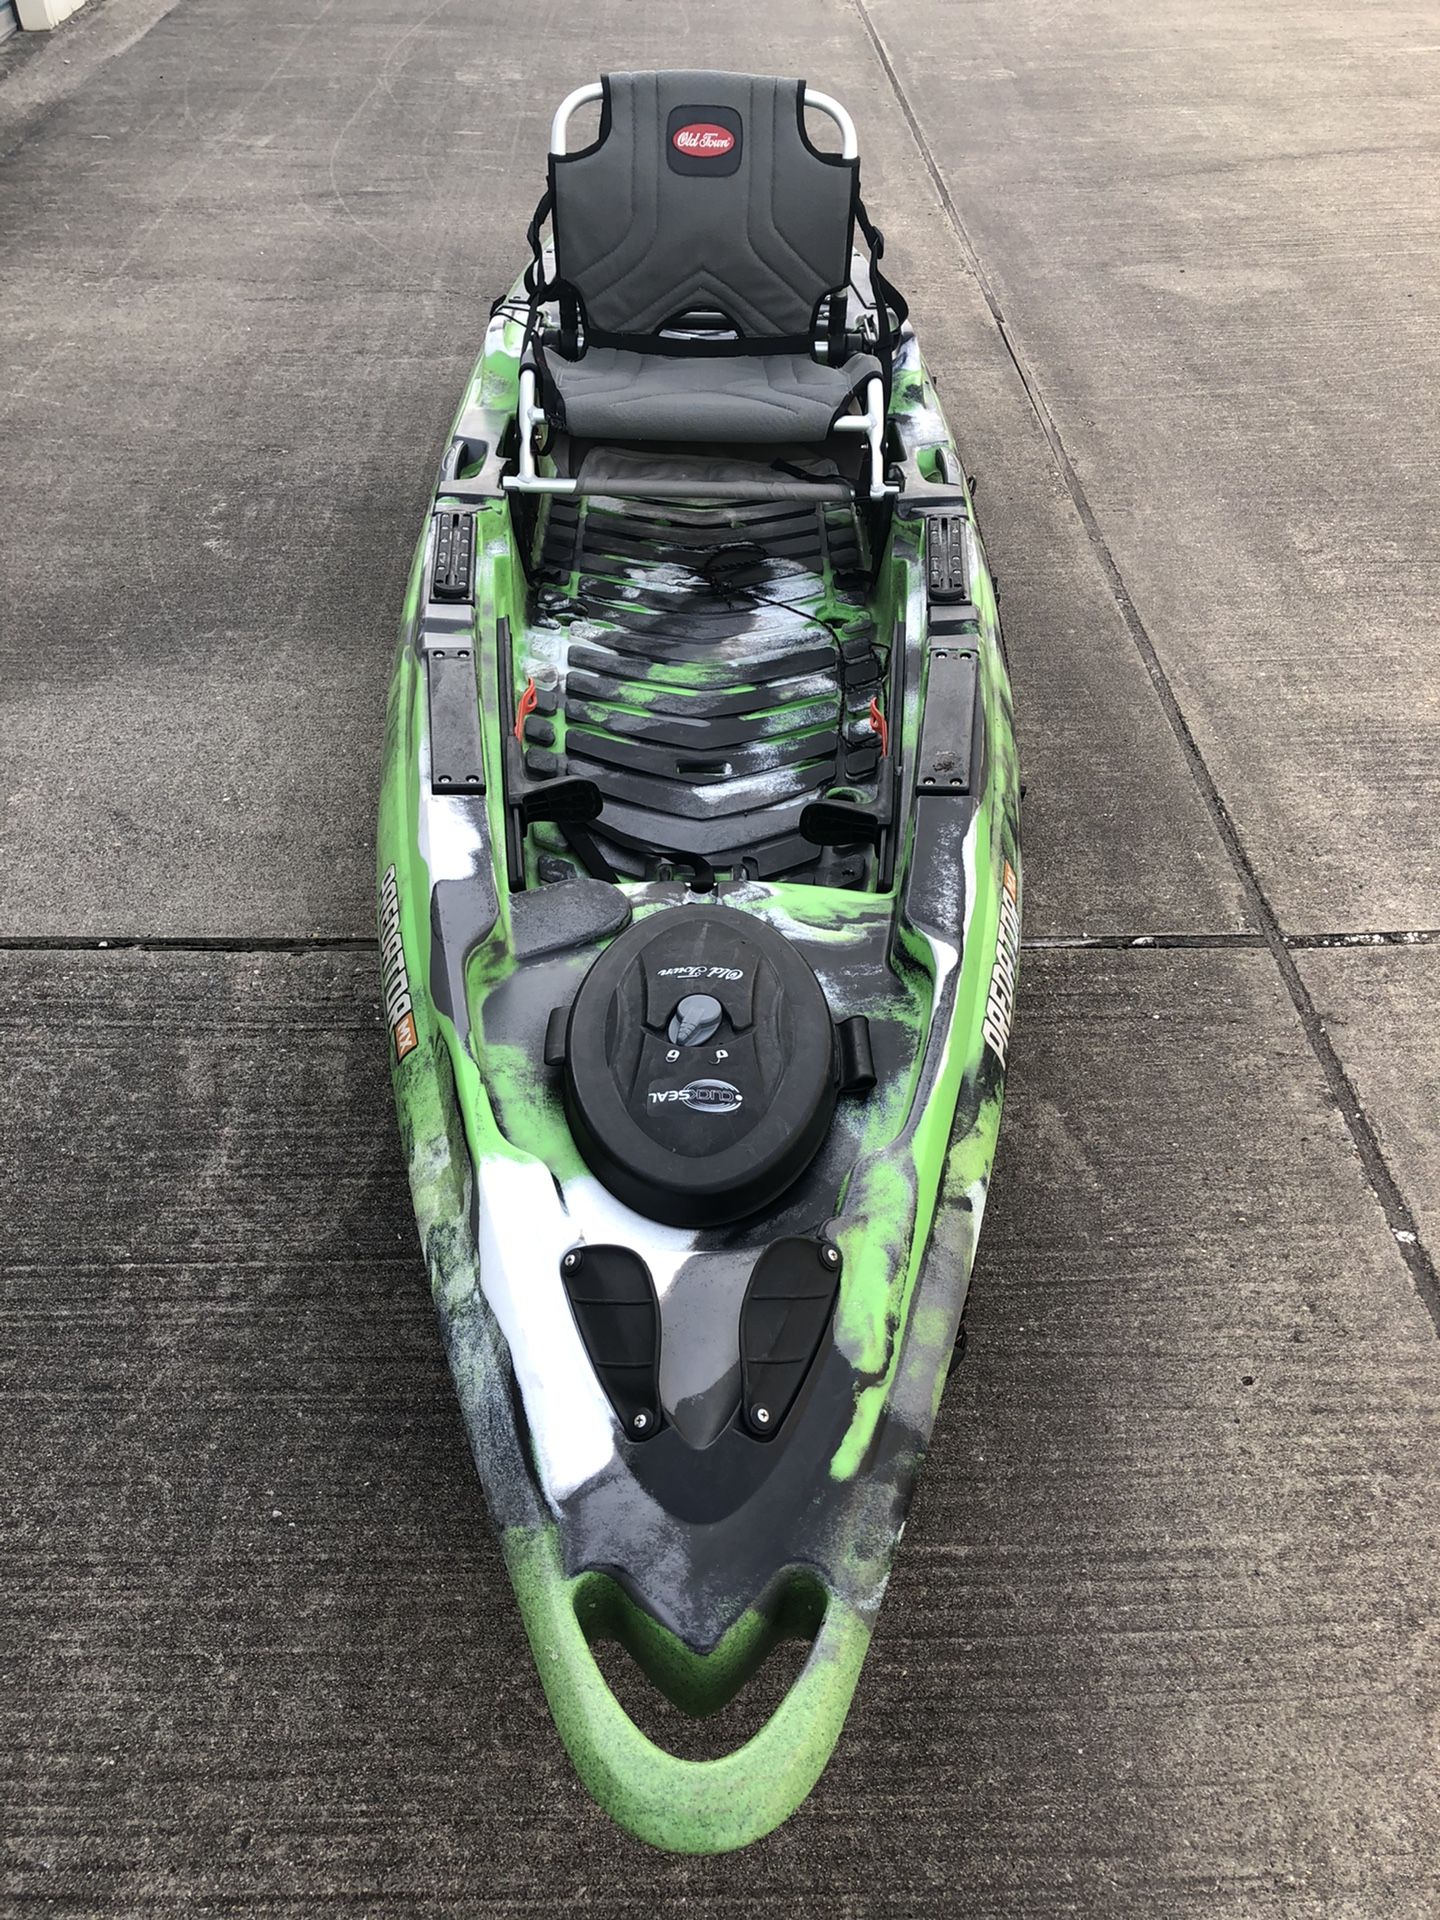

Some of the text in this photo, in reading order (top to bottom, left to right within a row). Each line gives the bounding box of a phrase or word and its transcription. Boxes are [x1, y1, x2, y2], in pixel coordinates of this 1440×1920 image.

[677, 131, 730, 147] Old Town
[381, 864, 413, 1051] PREDATOR MX
[658, 966, 743, 981] Old Town
[982, 887, 1020, 1071] PREDATOR
